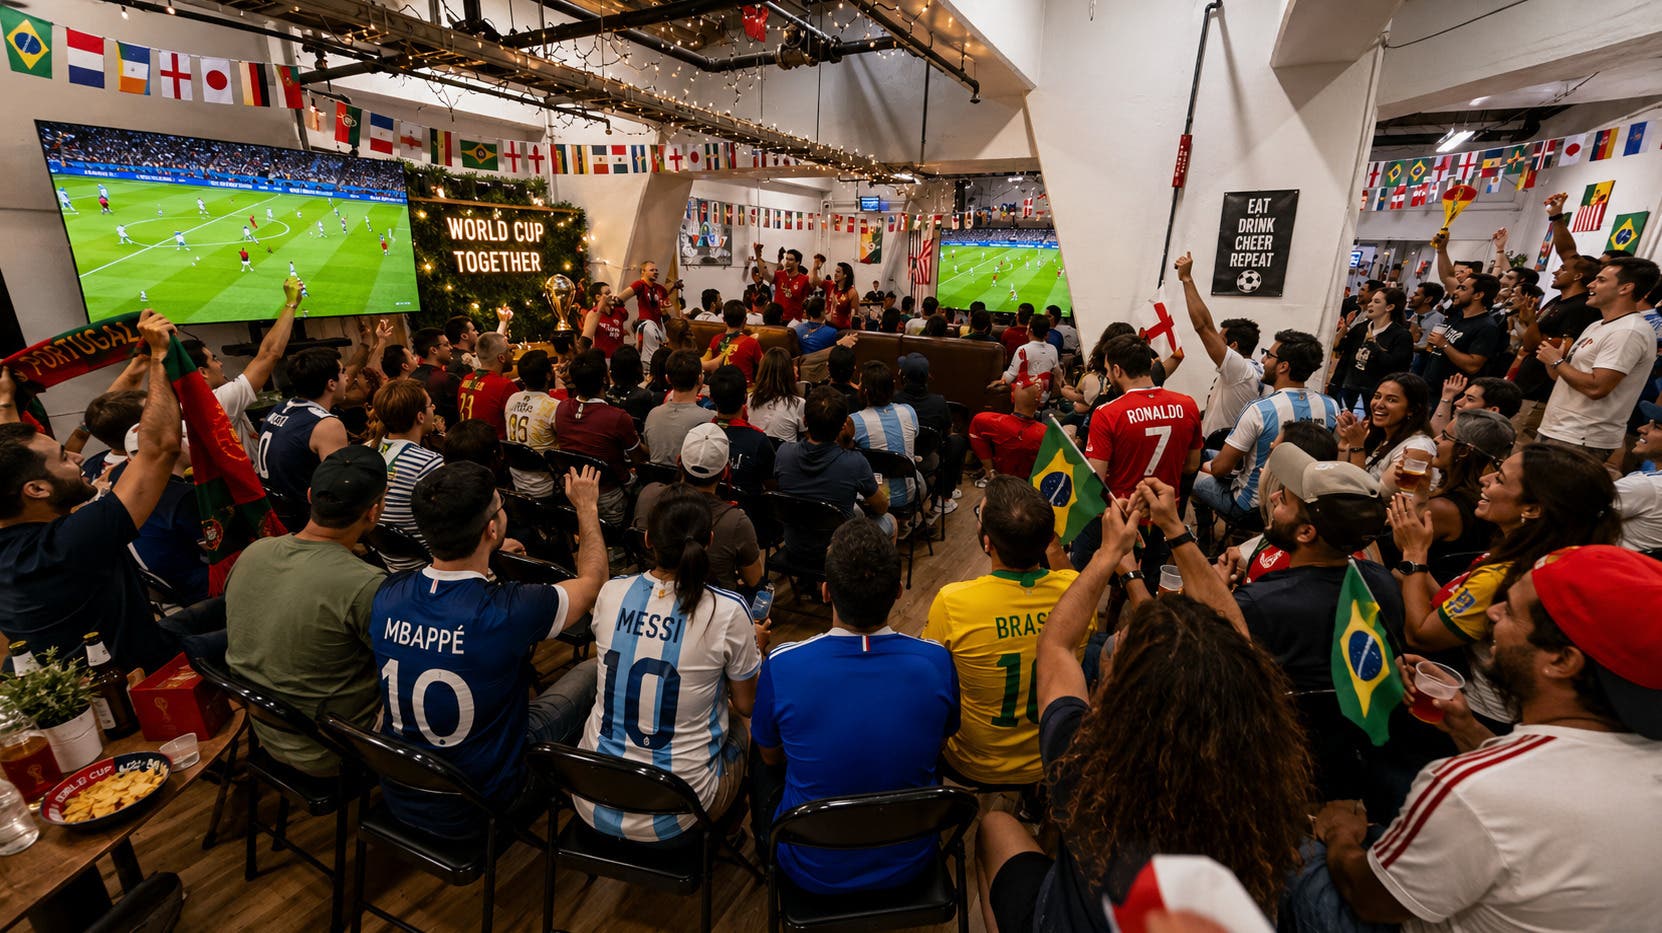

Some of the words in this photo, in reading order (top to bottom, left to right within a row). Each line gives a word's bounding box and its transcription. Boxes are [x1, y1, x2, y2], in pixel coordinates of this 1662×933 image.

[1247, 198, 1272, 214] EAT
[446, 216, 509, 241] WORLD
[514, 221, 544, 243] CUP
[1235, 235, 1273, 251] CHEER
[453, 250, 542, 273] TOGETHER
[1229, 252, 1274, 268] REPEAT
[18, 321, 140, 376] PORTUGAL
[1126, 404, 1184, 424] RONALDO
[1143, 425, 1172, 477] 7
[384, 617, 465, 655] MBAPPÉ
[616, 607, 682, 644] MESSI
[995, 611, 1051, 640] BRAS
[381, 658, 475, 748] 10
[600, 649, 681, 750] 10
